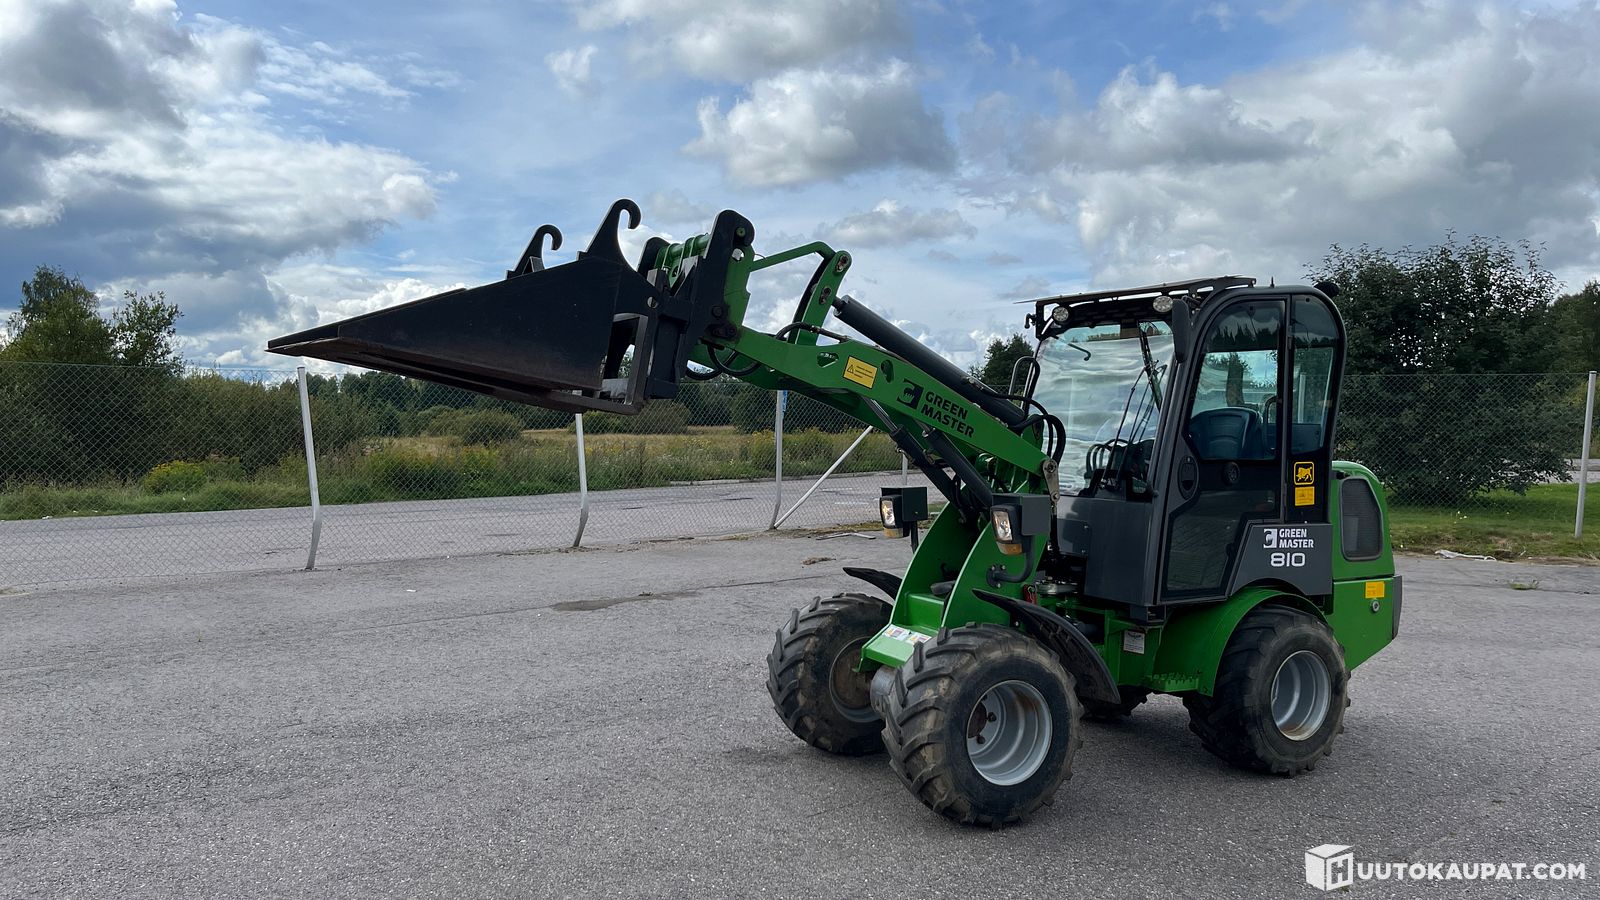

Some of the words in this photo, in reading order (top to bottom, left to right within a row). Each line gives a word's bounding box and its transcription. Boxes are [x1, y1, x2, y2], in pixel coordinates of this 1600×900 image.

[925, 391, 968, 420] GREEN
[921, 403, 975, 438] MASTER
[1279, 528, 1307, 538] GREEN
[1279, 539, 1314, 548] MASTER
[1270, 552, 1306, 567] 810
